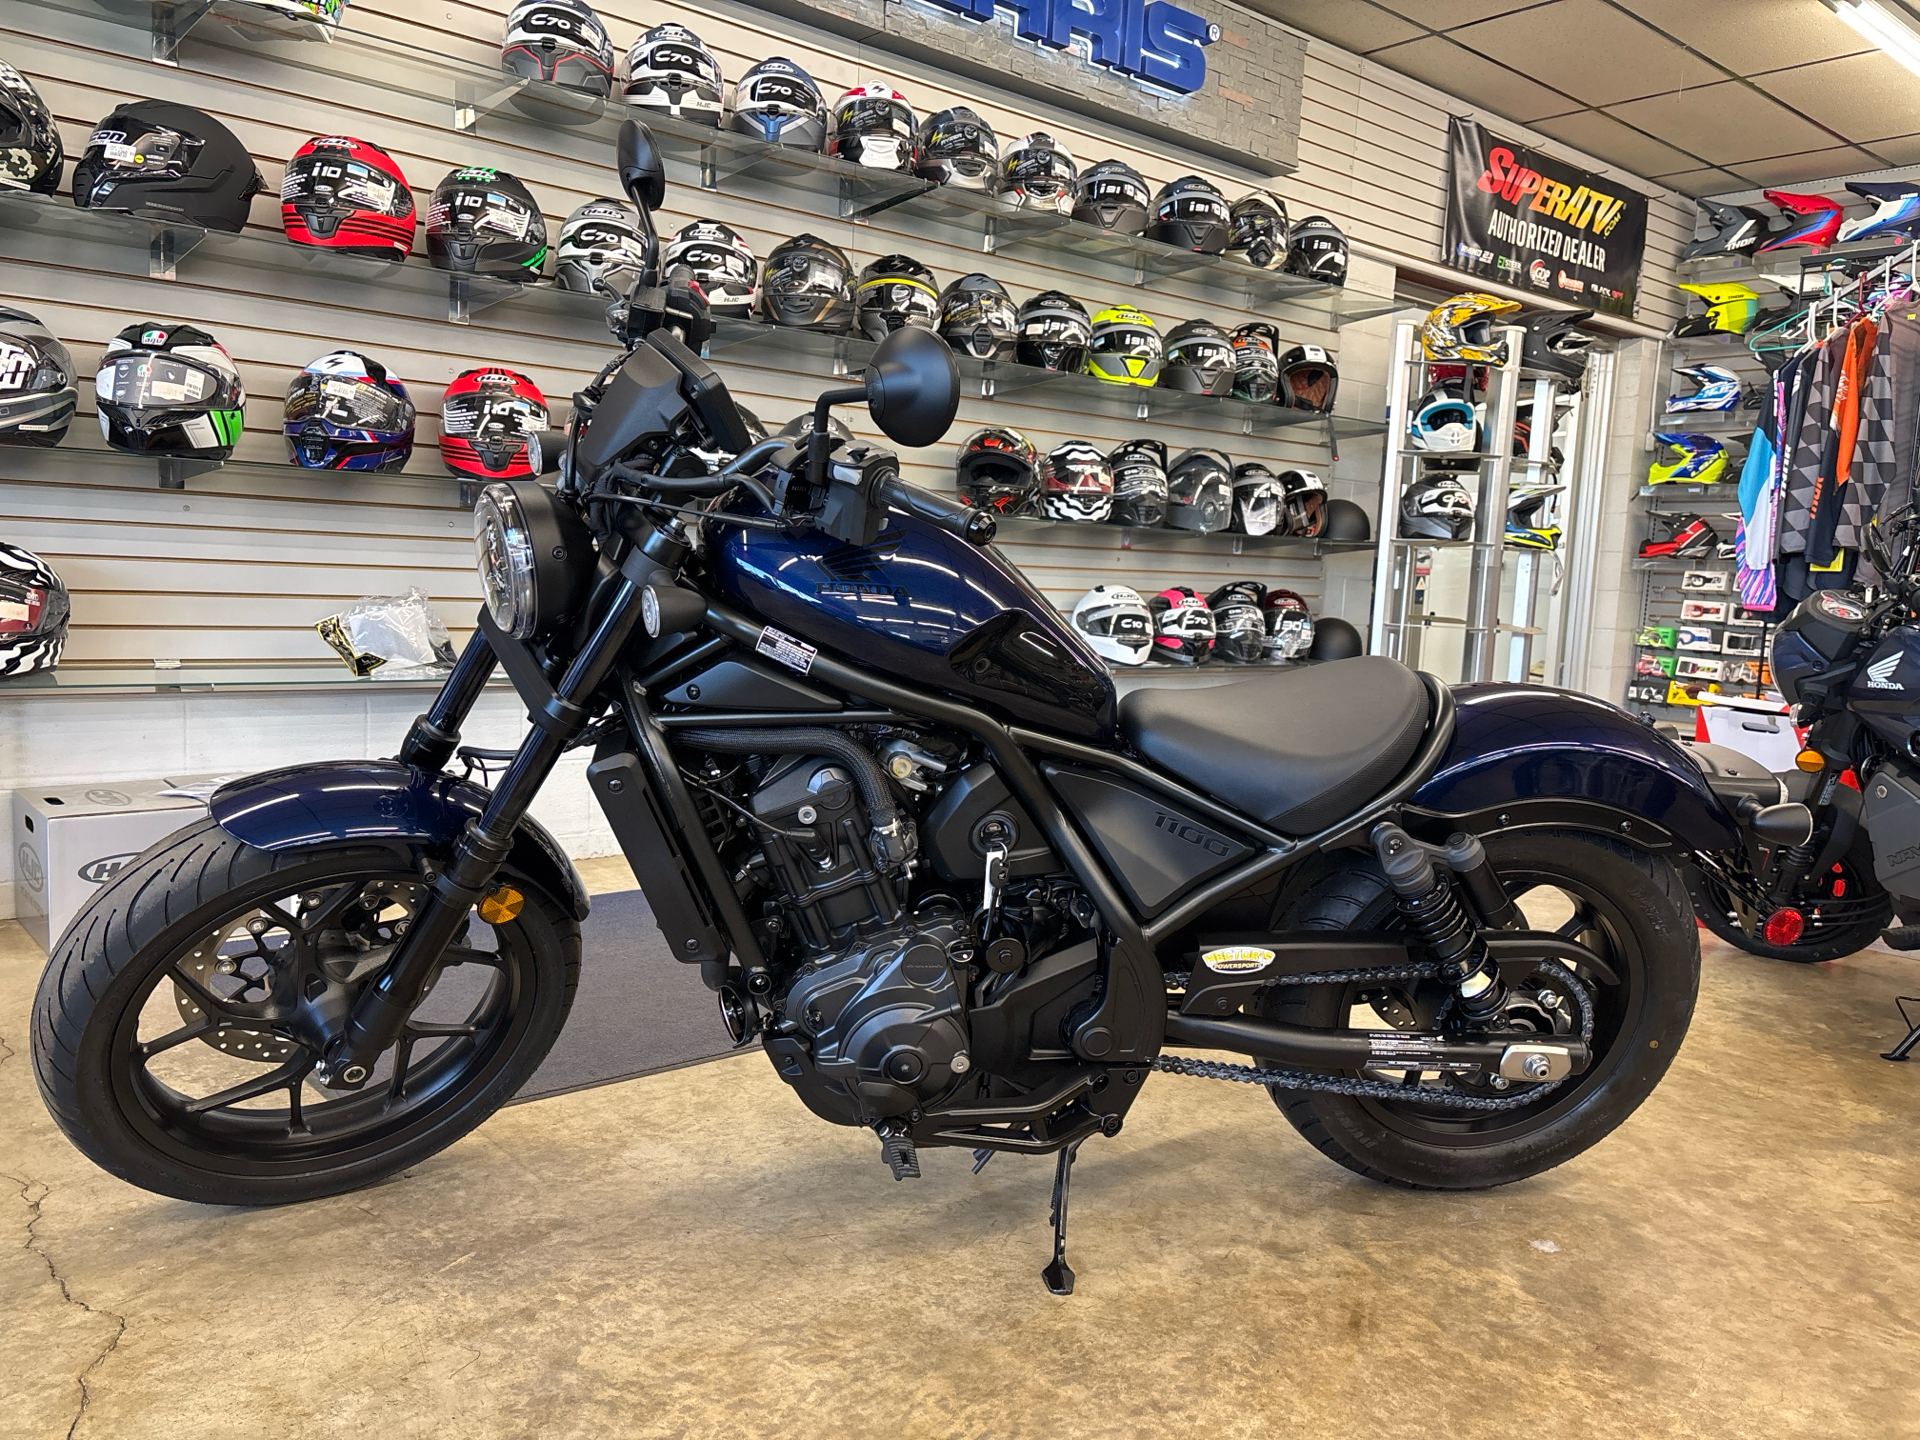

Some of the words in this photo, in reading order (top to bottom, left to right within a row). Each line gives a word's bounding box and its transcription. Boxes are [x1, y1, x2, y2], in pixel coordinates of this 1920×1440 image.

[530, 13, 571, 30] C70
[654, 50, 693, 65] C70
[758, 82, 793, 96] C70
[311, 162, 342, 178] i10
[455, 192, 483, 207] i10
[580, 229, 619, 243] C70
[1488, 209, 1561, 258] AUTHORIZED
[1563, 239, 1606, 273] DEALER
[1725, 236, 1758, 251] THOR
[686, 250, 723, 263] C70
[144, 337, 164, 345] agv
[815, 582, 911, 598] HONDA
[1120, 619, 1143, 629] C10
[1183, 615, 1208, 625] C70
[1867, 681, 1905, 691] HONDA
[1155, 811, 1231, 857] 1100
[1203, 948, 1274, 963] HECTOR'S
[1213, 962, 1263, 970] POWERSPORTS
